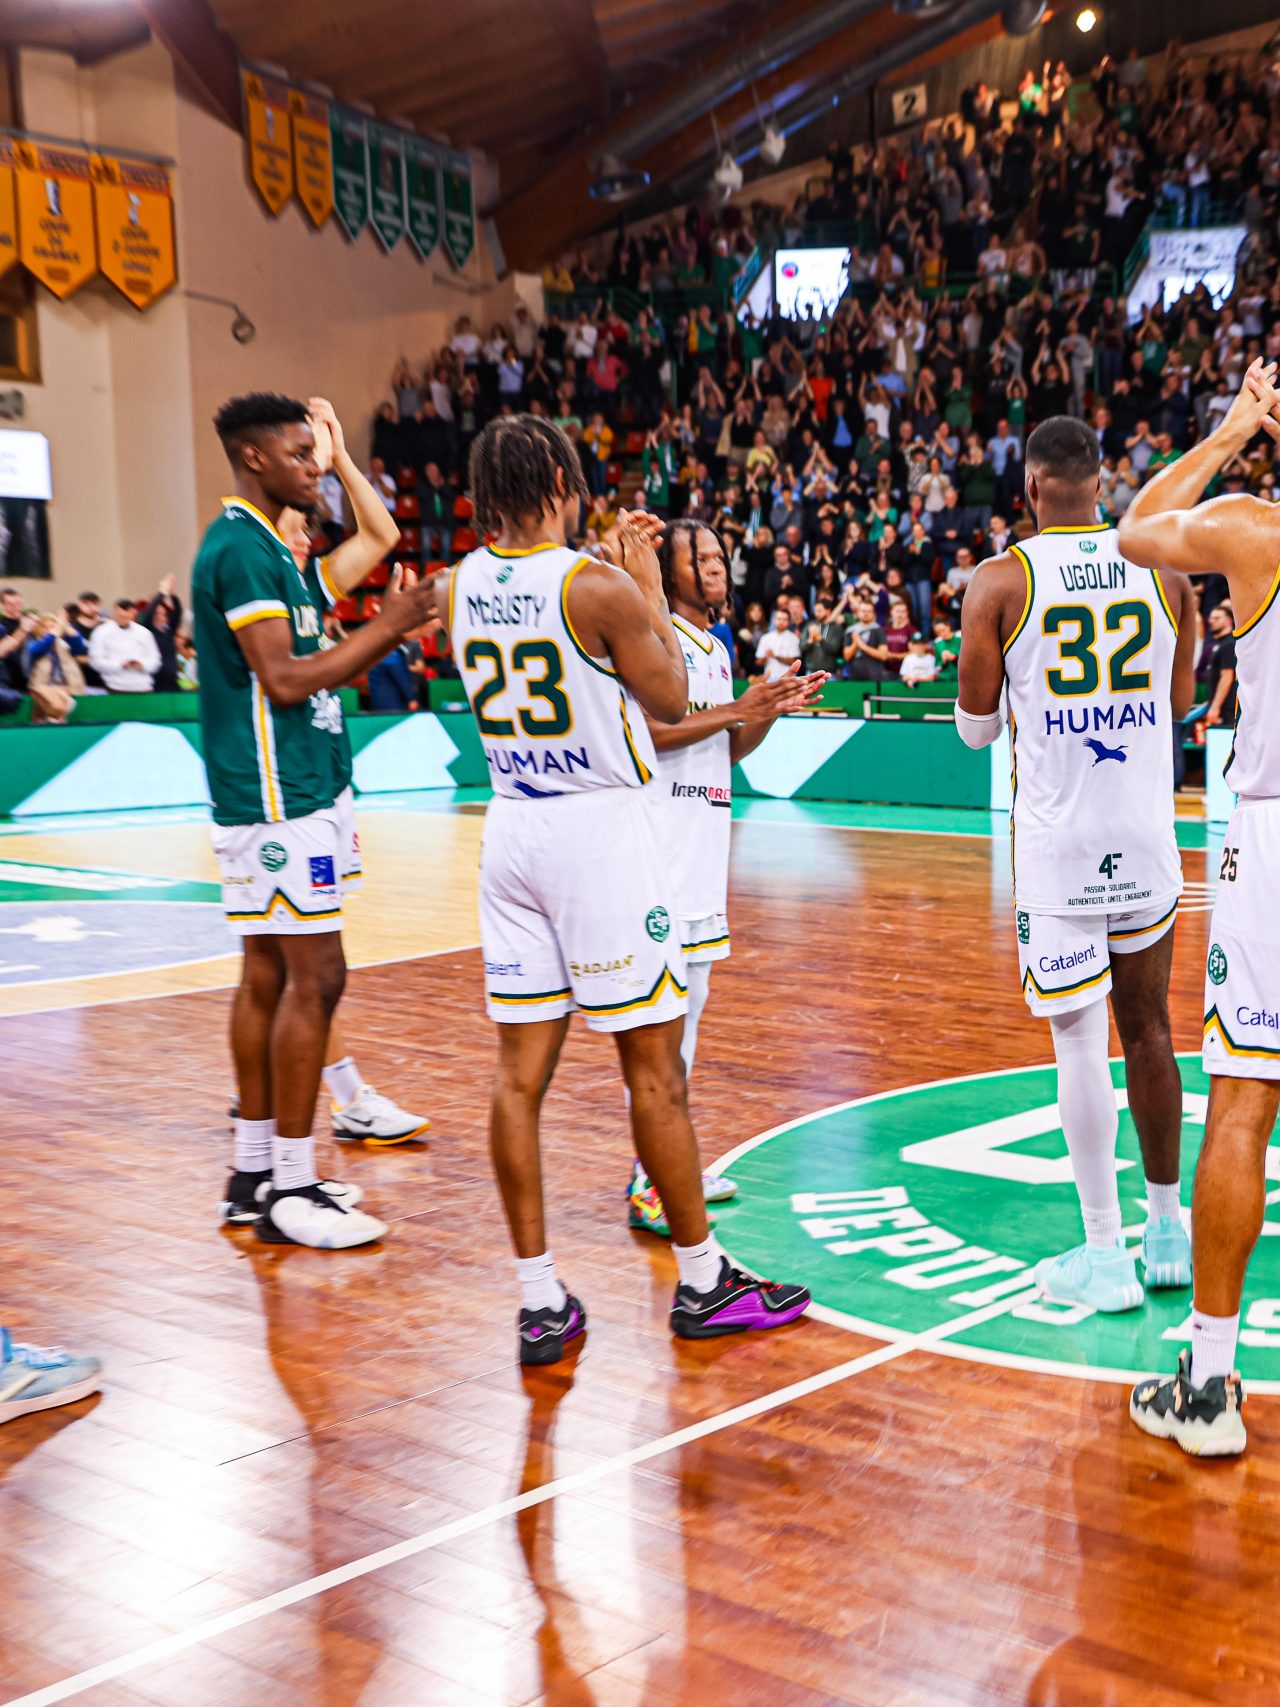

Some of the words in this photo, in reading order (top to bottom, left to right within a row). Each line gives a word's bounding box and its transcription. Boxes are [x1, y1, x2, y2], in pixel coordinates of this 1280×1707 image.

[1059, 561, 1126, 592] UGOLIN
[1042, 598, 1154, 699] 32
[464, 637, 574, 740] 23
[1045, 701, 1156, 736] HUMAN
[1219, 847, 1240, 882] 25
[1083, 885, 1106, 894] PASSION
[1039, 944, 1097, 973] Catalent
